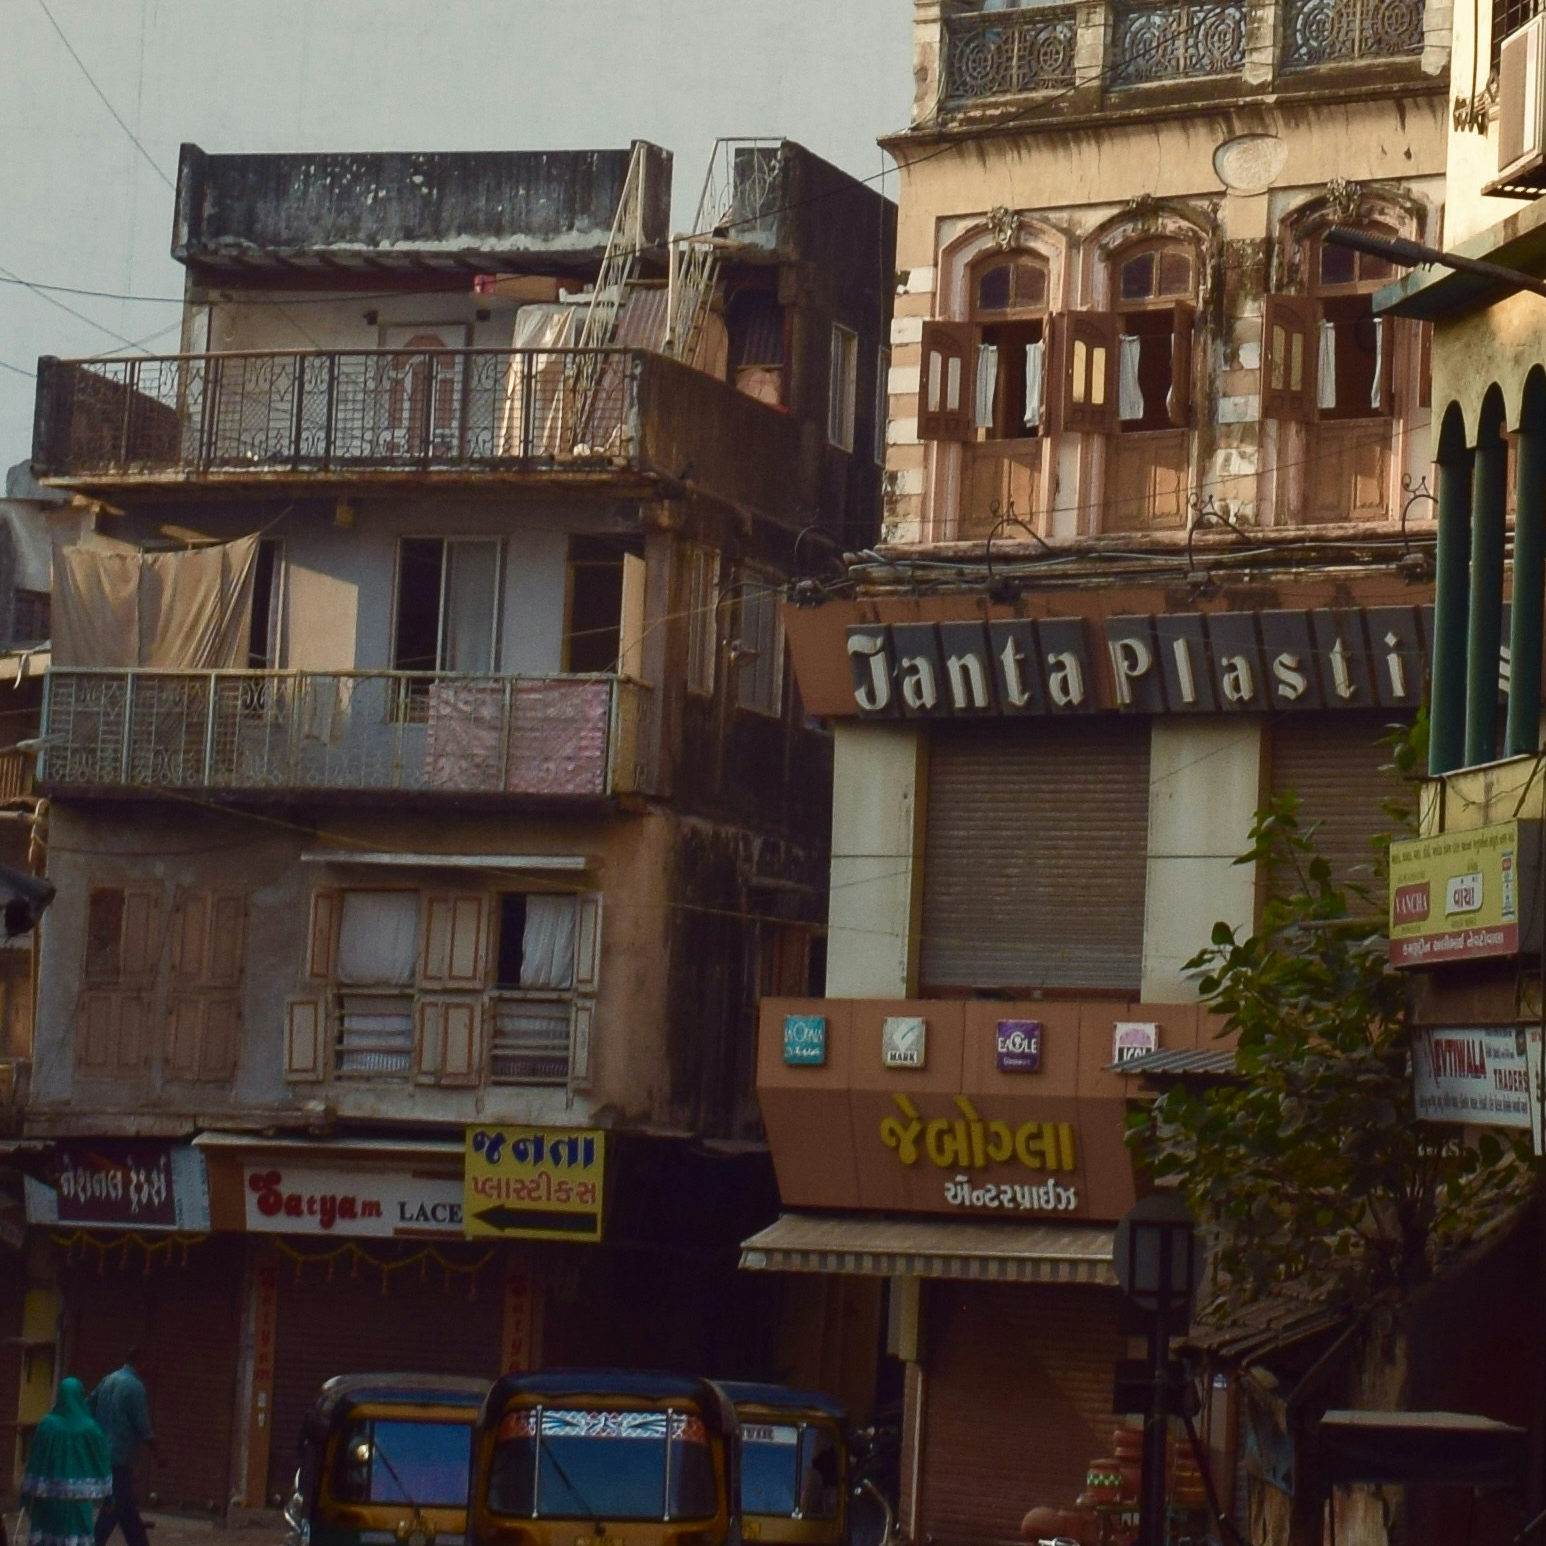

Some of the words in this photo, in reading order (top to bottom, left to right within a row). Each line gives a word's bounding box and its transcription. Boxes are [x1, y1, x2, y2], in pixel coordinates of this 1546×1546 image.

[846, 635, 1086, 712] Janta
[1108, 629, 1512, 707] Plasti
[997, 1031, 1038, 1054] EAGLE
[472, 1130, 595, 1169] જનતા
[60, 1153, 123, 1204] નેશનલ
[249, 1170, 383, 1230] Satyam
